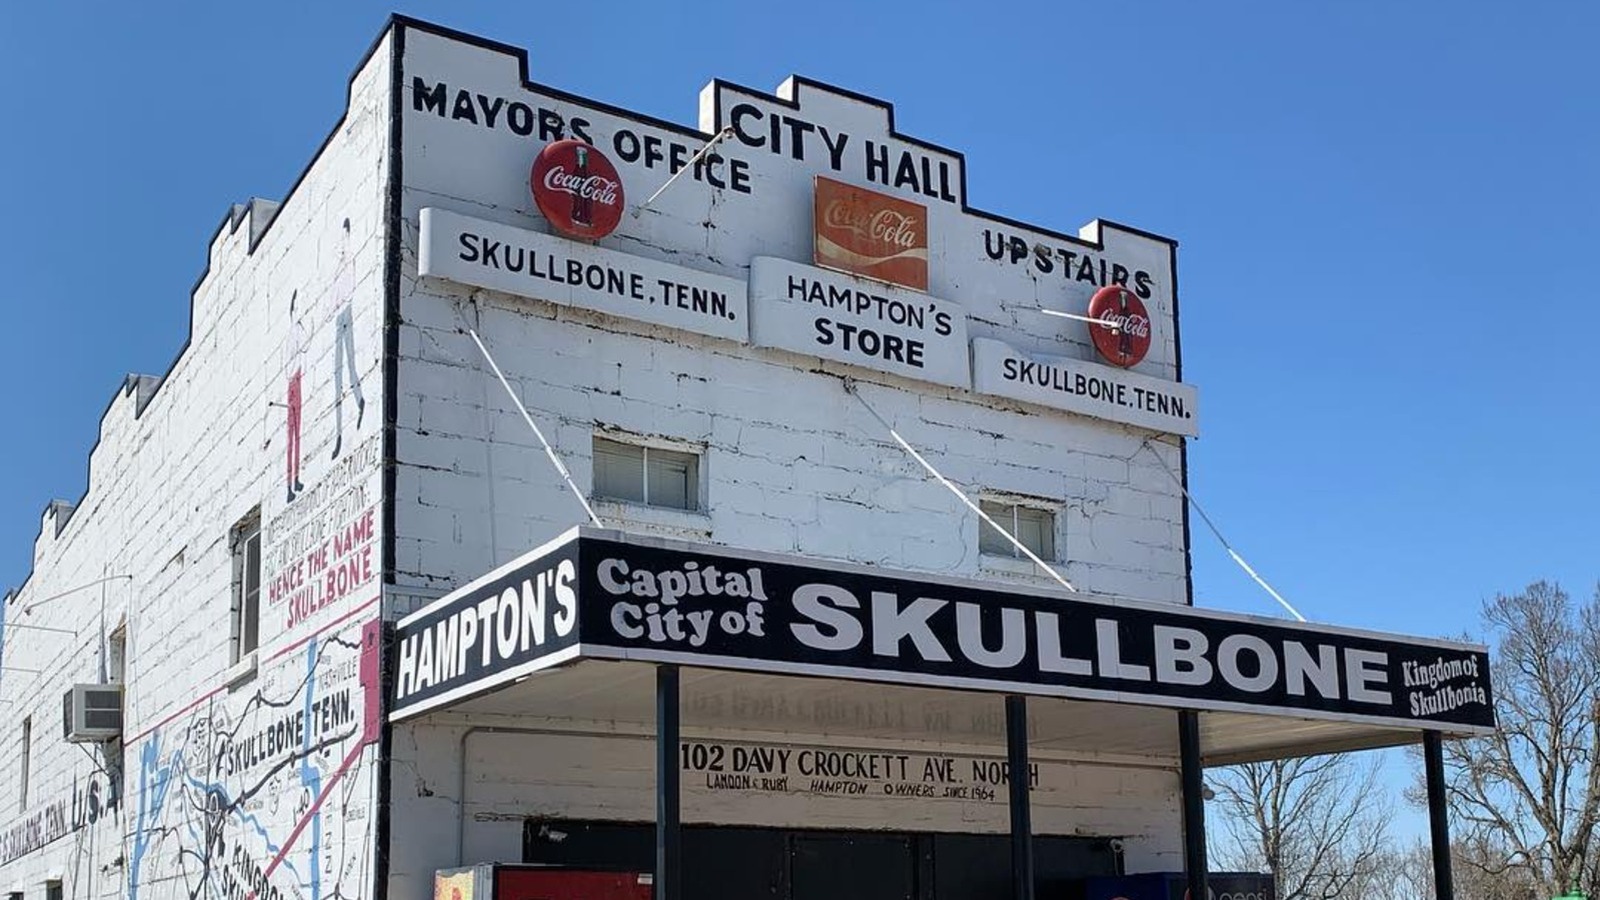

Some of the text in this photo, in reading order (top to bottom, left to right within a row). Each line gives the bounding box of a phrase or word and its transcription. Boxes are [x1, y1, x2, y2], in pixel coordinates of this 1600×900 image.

[413, 76, 752, 194] MAYORS OFFICE
[731, 102, 957, 203] CITY HALL
[543, 165, 618, 205] Coca-Cola
[984, 228, 1153, 299] UPSTAIRS
[788, 275, 952, 336] HAMPTON'S
[815, 319, 925, 367] STORE
[268, 560, 304, 606] HENCE
[308, 541, 330, 579] THE
[334, 509, 375, 562] NAME
[287, 545, 372, 629] SKULLBONE
[597, 557, 768, 604] Capital
[397, 558, 577, 699] HAMPTON'S
[610, 602, 765, 648] City of
[789, 583, 1392, 706] SKULLBONE
[1402, 654, 1479, 690] Kingdom of
[1409, 681, 1487, 717] Skullbonia
[226, 709, 304, 777] SKULLBONE
[312, 688, 355, 738] TENN.
[682, 743, 1039, 787] 102 DAVY CROCKETT AVE. NORH
[706, 773, 750, 790] LANDON
[762, 777, 789, 792] RUBY
[810, 779, 868, 795] HAMPTON
[884, 783, 936, 799] OWNERS
[942, 786, 969, 798] SINCE
[970, 787, 996, 801] 1964
